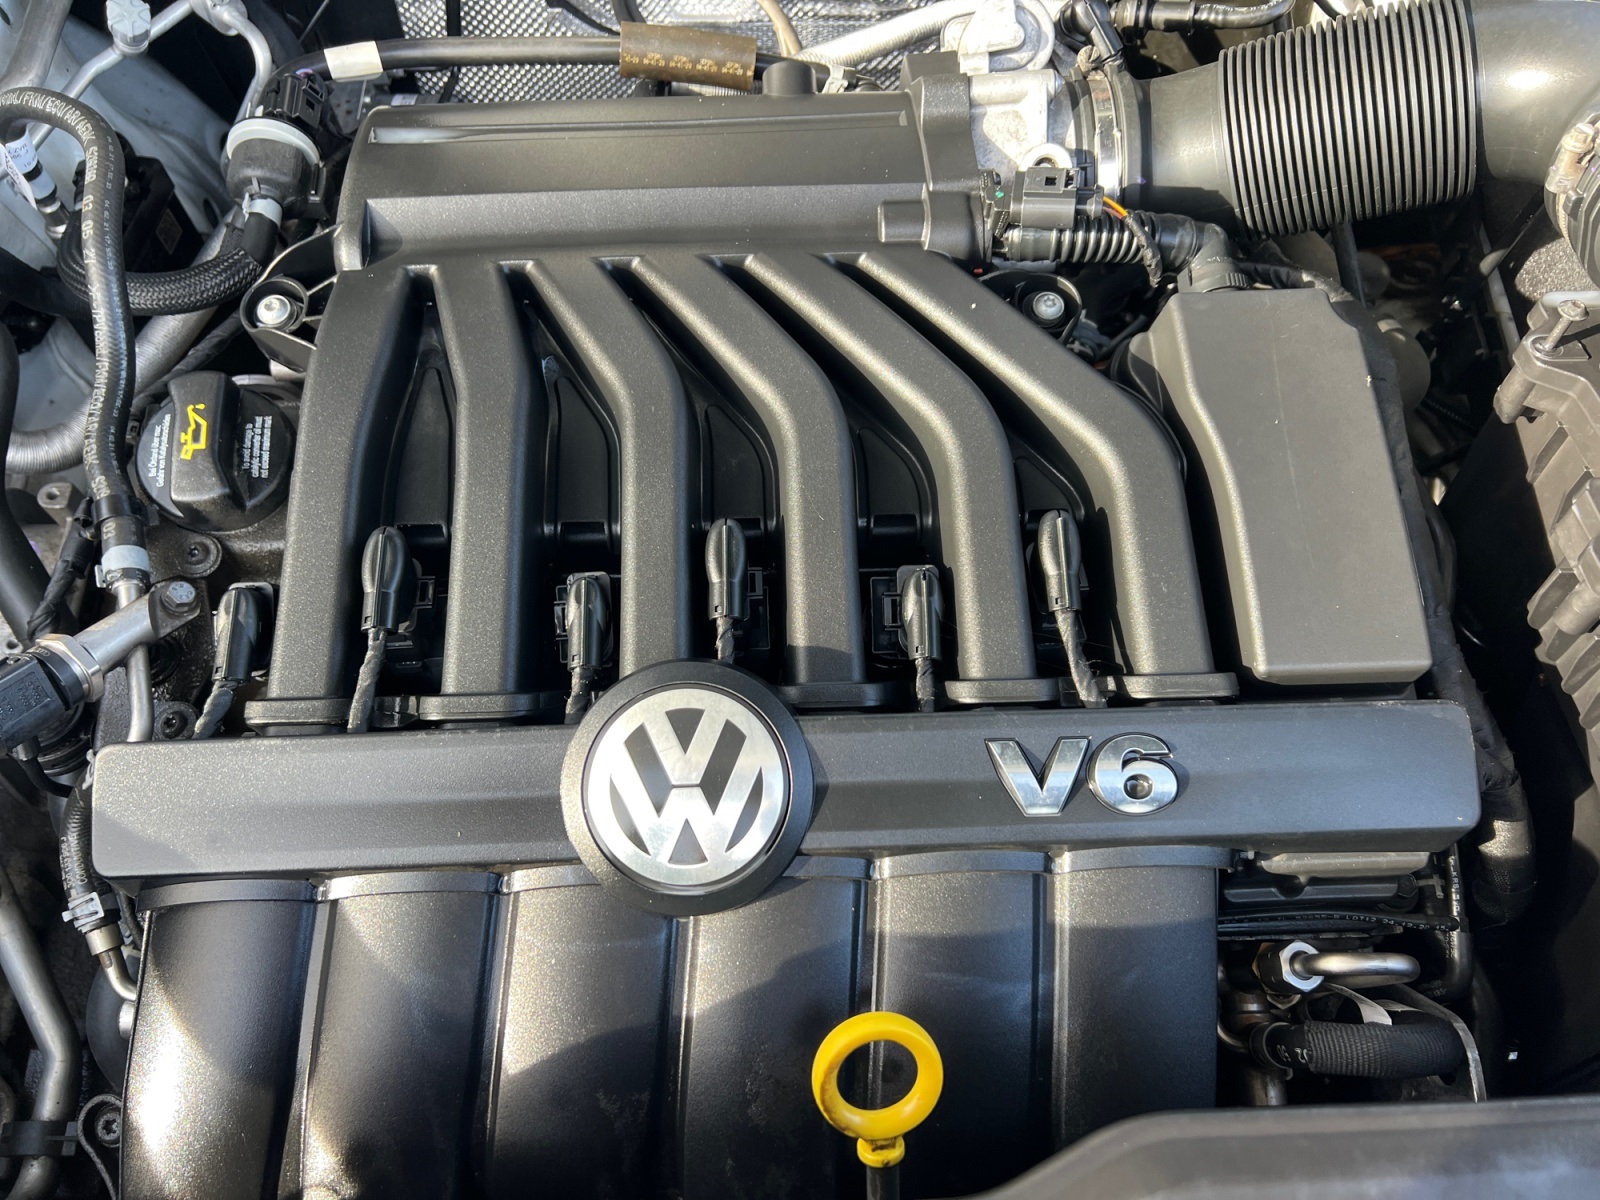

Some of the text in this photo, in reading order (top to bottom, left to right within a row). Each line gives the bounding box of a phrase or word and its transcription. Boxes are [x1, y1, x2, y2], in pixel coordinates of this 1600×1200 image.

[151, 436, 160, 448] über
[243, 429, 254, 448] damage
[251, 434, 262, 457] converter
[147, 448, 158, 468] Ölstand
[158, 459, 166, 469] von
[242, 448, 251, 462] avoid
[260, 450, 270, 470] exceed
[148, 468, 157, 477] Bei
[241, 462, 250, 470] To
[250, 457, 261, 478] catalytic
[260, 469, 269, 479] not
[156, 469, 165, 488] Gefahr
[985, 732, 1180, 817] V6
[587, 687, 788, 886] VW
